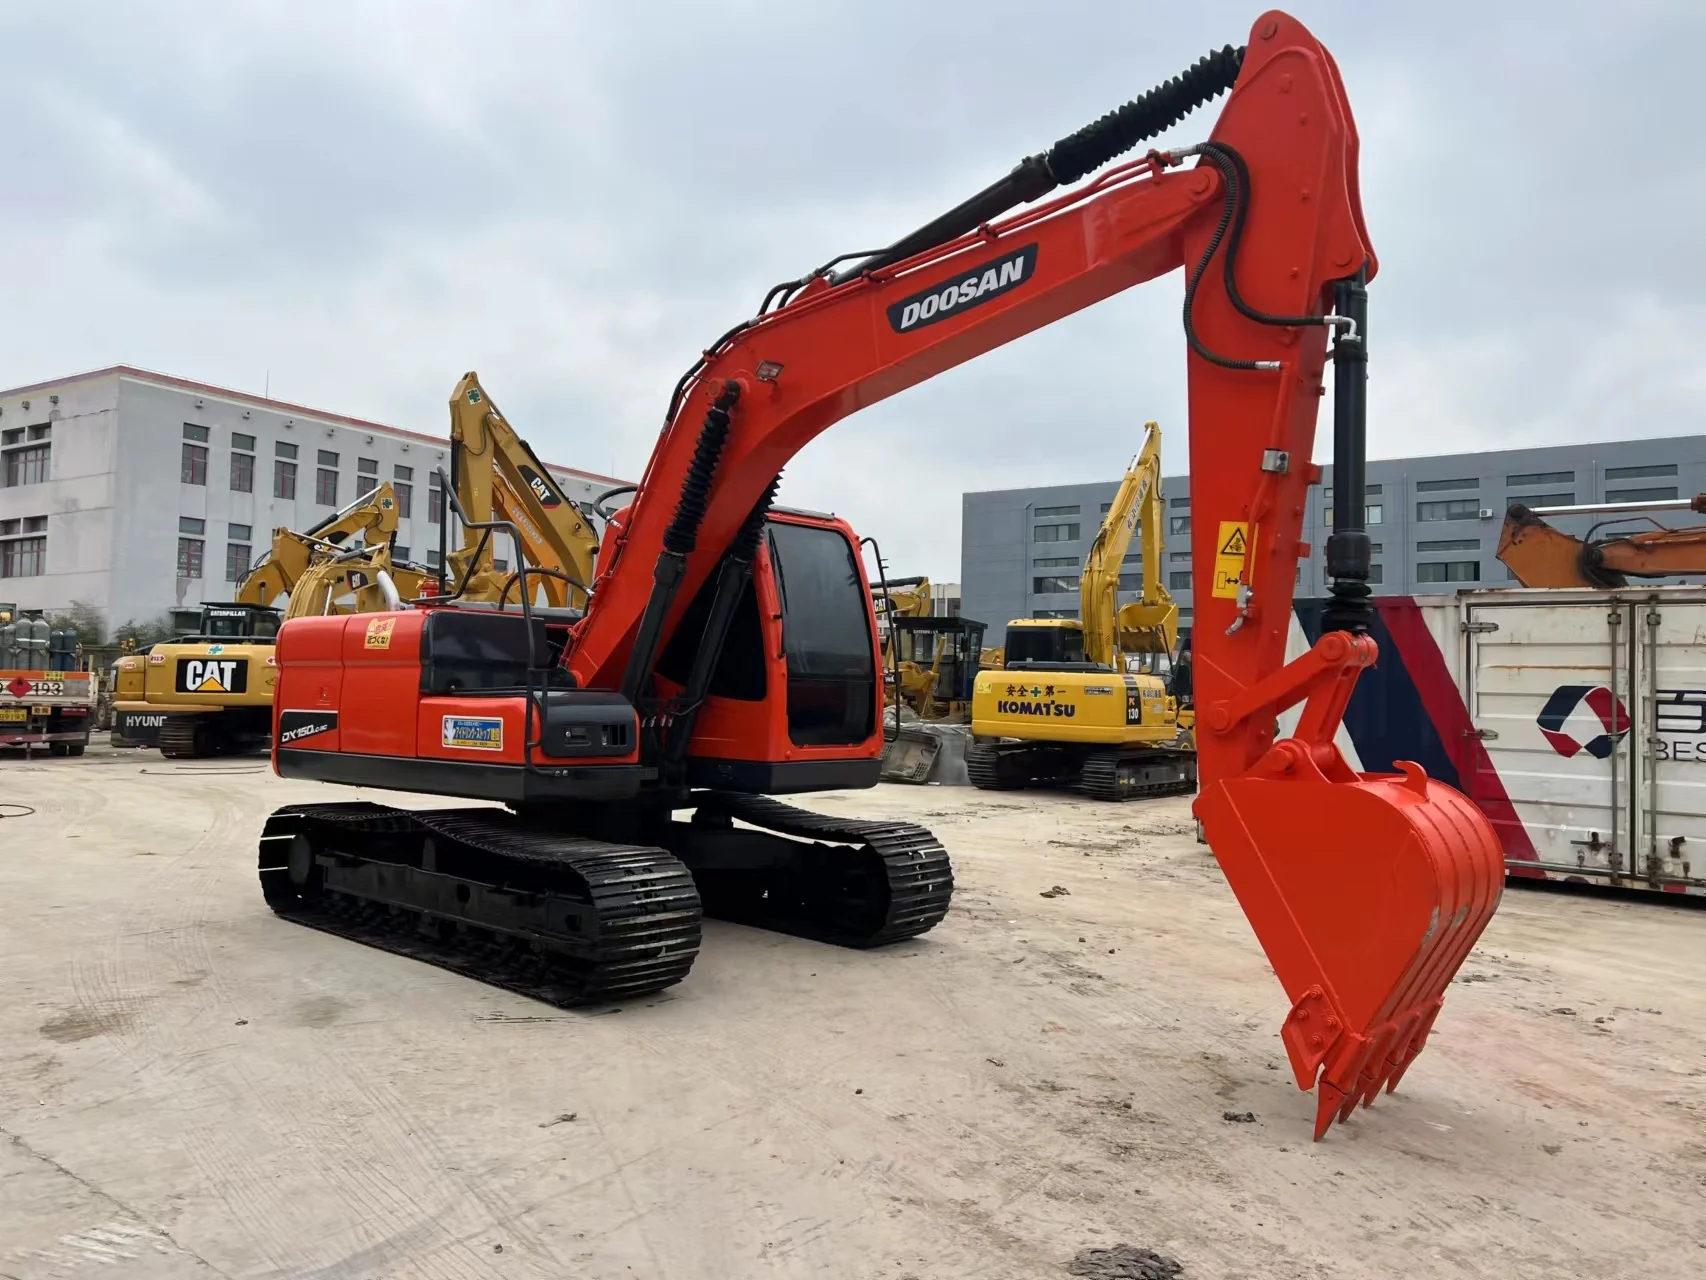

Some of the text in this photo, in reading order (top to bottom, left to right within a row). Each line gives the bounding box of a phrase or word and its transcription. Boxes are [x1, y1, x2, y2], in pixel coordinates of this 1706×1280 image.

[900, 255, 1025, 330] DOOSAN
[530, 476, 551, 502] CAT
[873, 598, 887, 613] CAT
[186, 660, 237, 692] CAT
[1006, 684, 1067, 697] 安全 第一
[997, 700, 1076, 718] KOMATSU
[1128, 708, 1139, 720] 130
